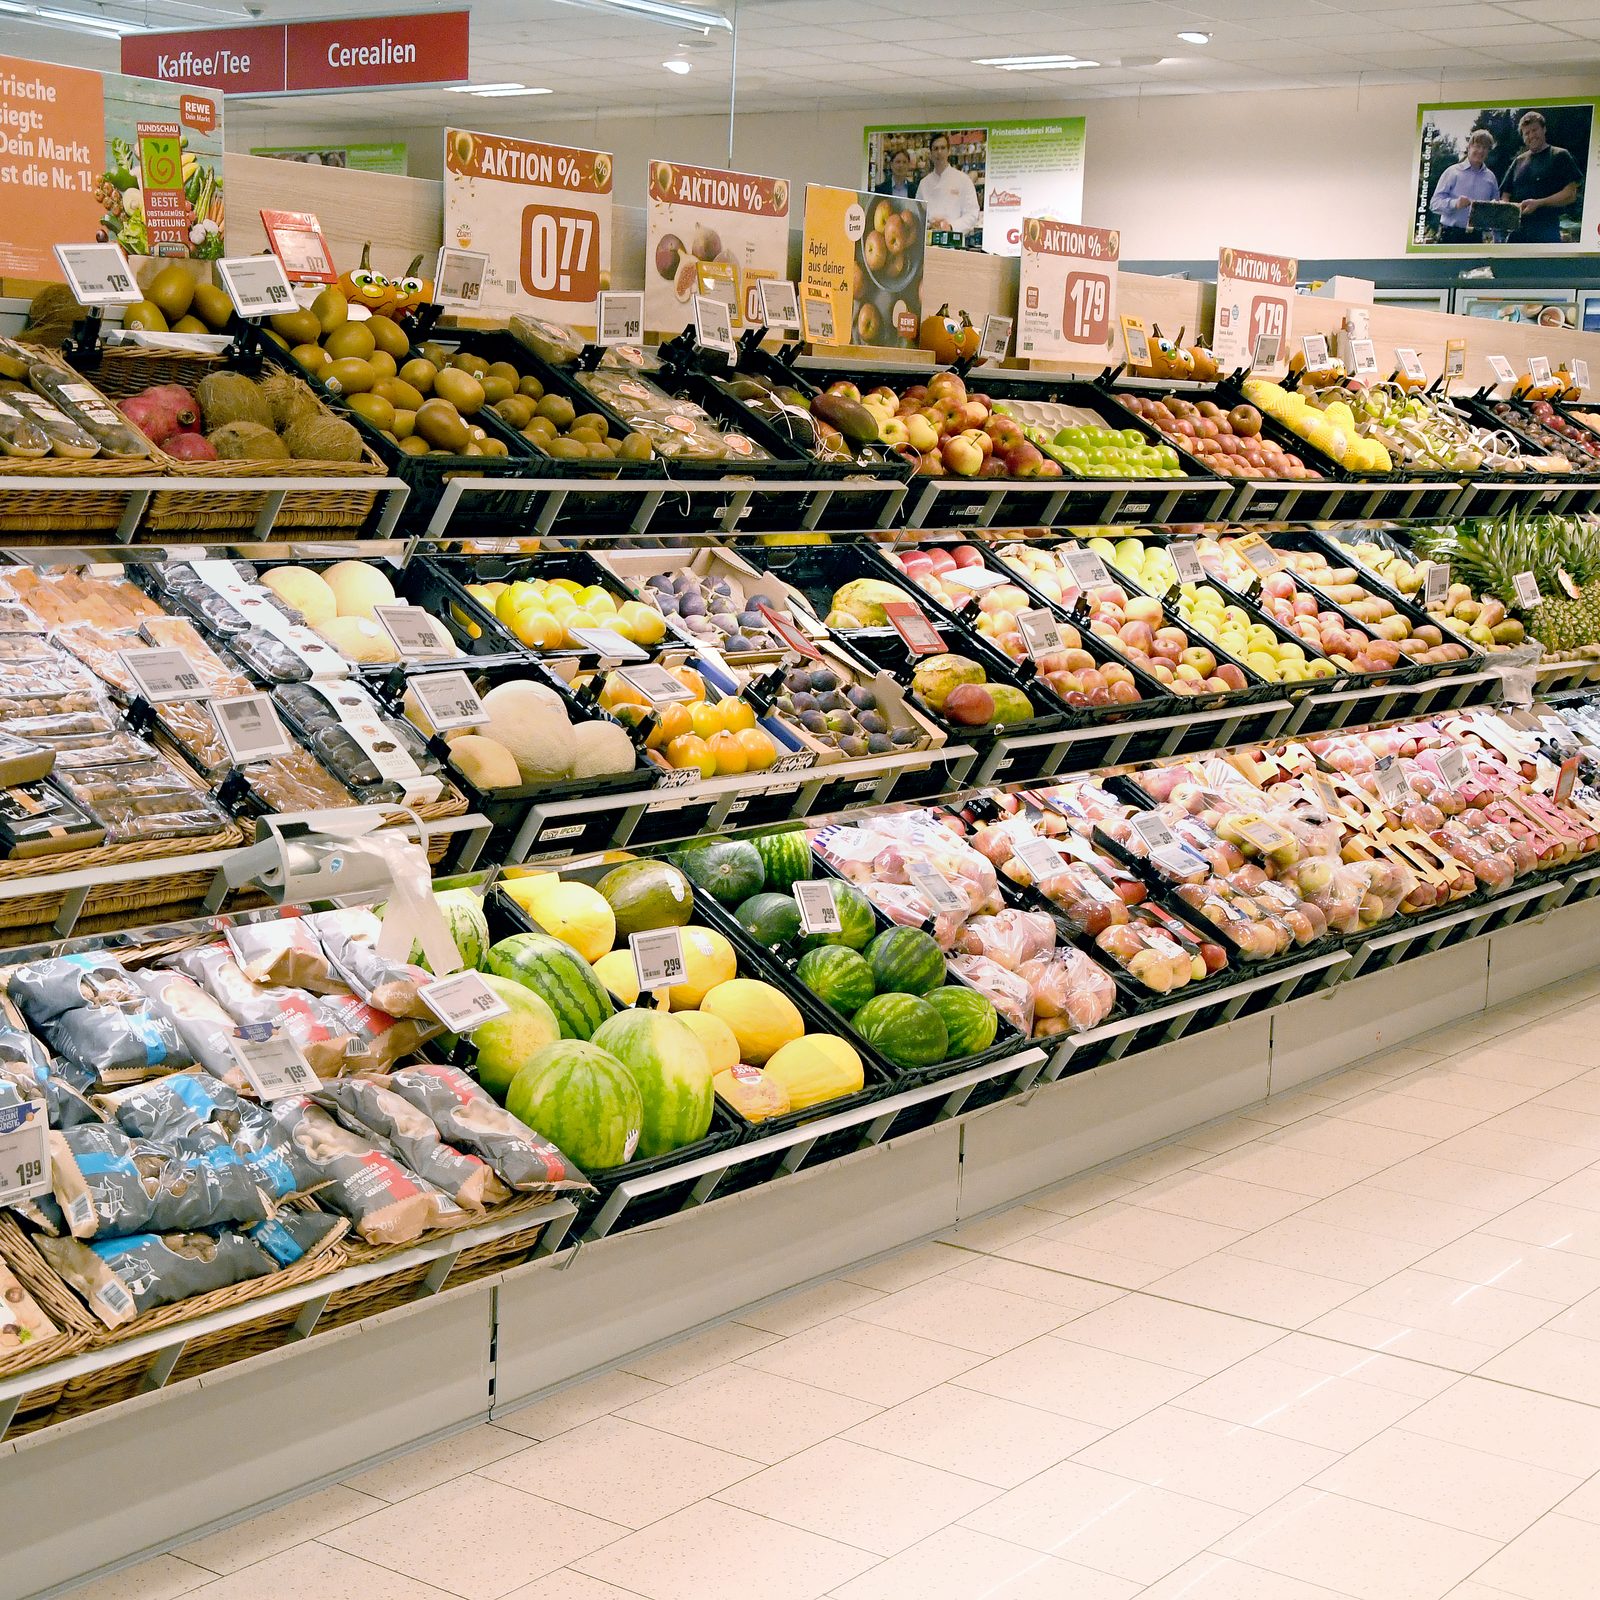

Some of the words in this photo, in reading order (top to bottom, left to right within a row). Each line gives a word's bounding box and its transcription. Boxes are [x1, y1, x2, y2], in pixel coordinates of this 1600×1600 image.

[328, 38, 416, 67] Cerealien
[157, 51, 251, 78] Kaffee/Tee
[185, 101, 211, 115] REWE
[185, 113, 196, 121] Dein
[137, 123, 179, 133] RUNDSCHAU
[38, 137, 90, 165] Markt
[1424, 145, 1432, 162] der
[481, 146, 553, 183] AKTION
[557, 157, 581, 187] %
[22, 164, 48, 187] die
[52, 167, 76, 191] Nr.
[78, 171, 92, 192] 1!
[679, 175, 740, 208] AKTION
[743, 184, 763, 211] %
[1418, 177, 1429, 214] Partner
[151, 197, 179, 208] BESTE
[147, 218, 186, 227] ABTEILUNG
[849, 214, 861, 222] Neue
[153, 230, 182, 242] 2021
[848, 224, 861, 232] Ernte
[1415, 214, 1426, 243] Starke
[808, 239, 828, 256] Äpfel
[1043, 229, 1086, 255] AKTION
[1088, 235, 1101, 257] %
[530, 213, 593, 293] 0.77
[807, 262, 821, 273] aus
[822, 261, 845, 275] deiner
[1235, 257, 1269, 281] AKTION
[1270, 264, 1282, 283] %
[107, 274, 130, 292] 1.79
[461, 281, 480, 299] 0.45
[265, 285, 288, 303] 1.99
[1070, 279, 1106, 338] 1.79
[624, 320, 640, 338] 1.49
[418, 632, 438, 648] 2.99
[175, 673, 199, 690] 1.99
[456, 699, 479, 716] 3.49
[151, 831, 176, 839] FEIGEN
[664, 957, 681, 977] 2.99
[284, 1065, 307, 1084] 1.69
[16, 1160, 42, 1186] 1.99
[343, 1162, 381, 1189] AROMATISCH
[364, 1178, 392, 1197] GERÖSTET
